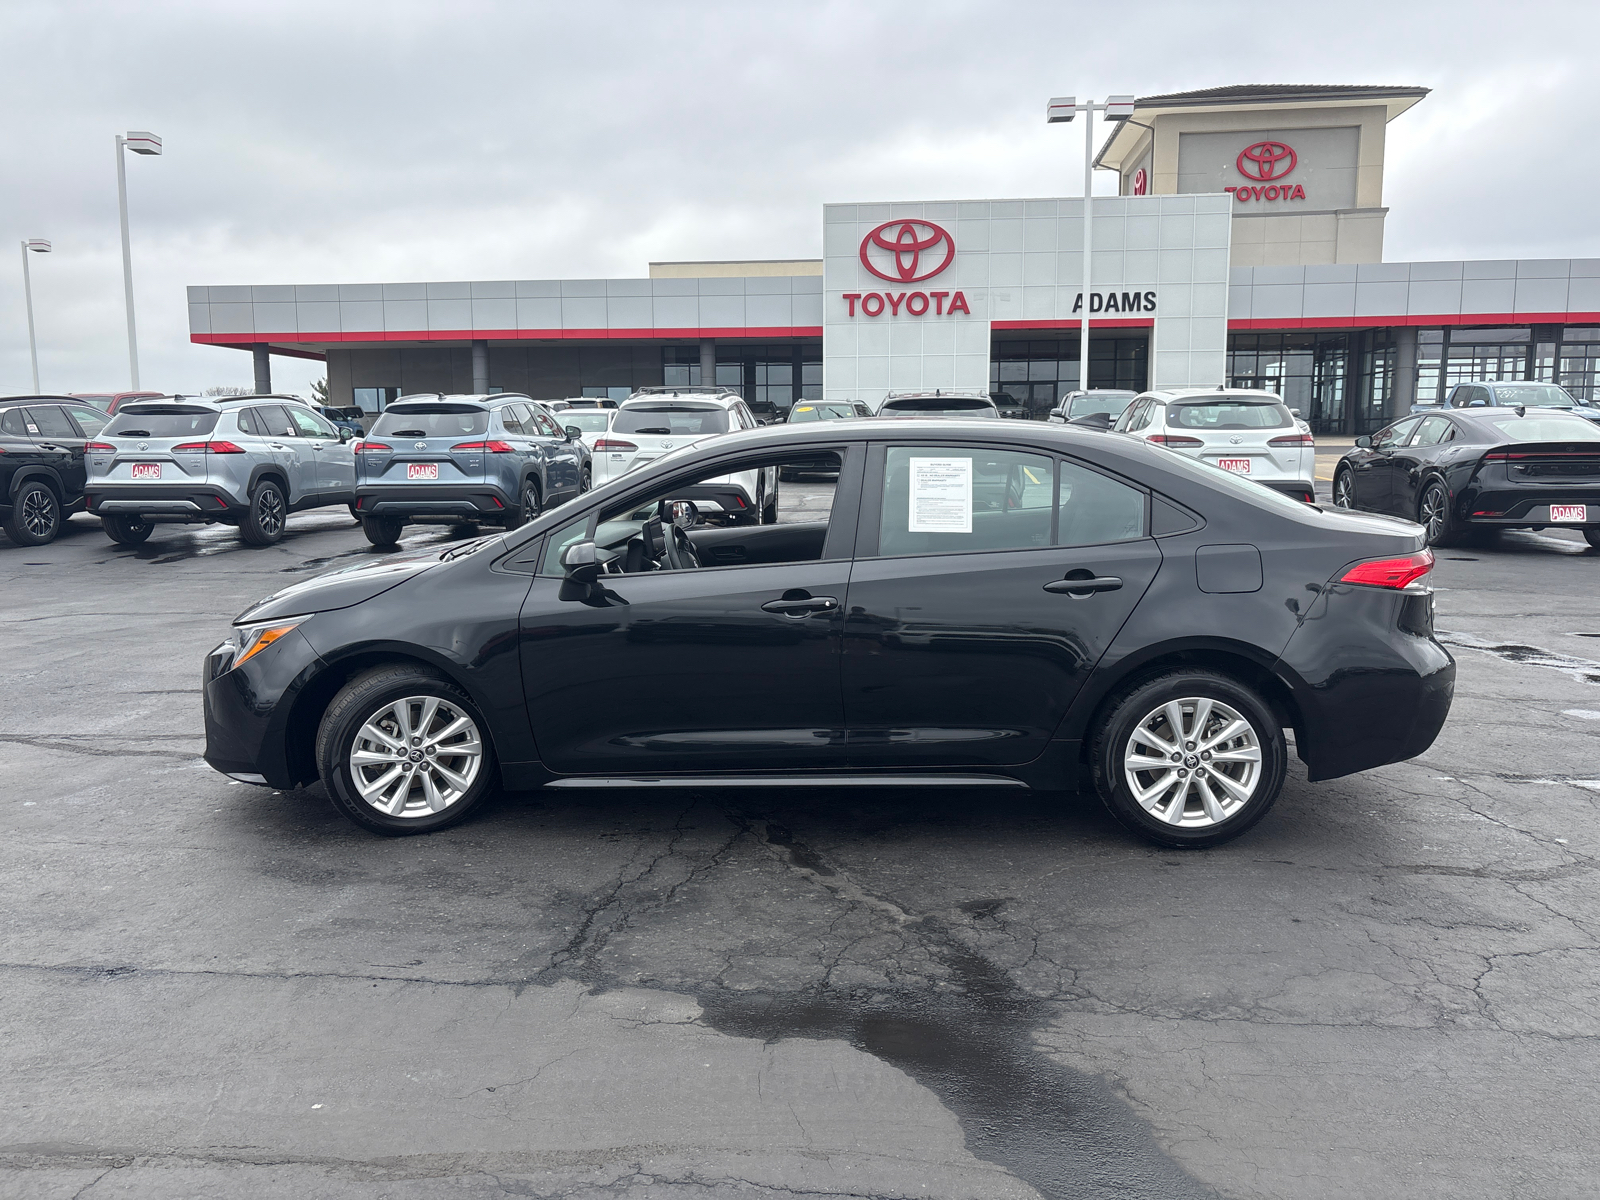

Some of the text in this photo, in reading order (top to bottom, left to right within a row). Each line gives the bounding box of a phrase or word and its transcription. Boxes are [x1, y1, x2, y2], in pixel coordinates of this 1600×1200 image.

[842, 291, 971, 317] TOYOTA
[1072, 291, 1156, 313] ADAMS
[133, 466, 158, 477] ADAMS
[410, 466, 435, 477] ADAMS
[1220, 461, 1248, 472] ADAMS
[1553, 508, 1583, 518] ADAMS
